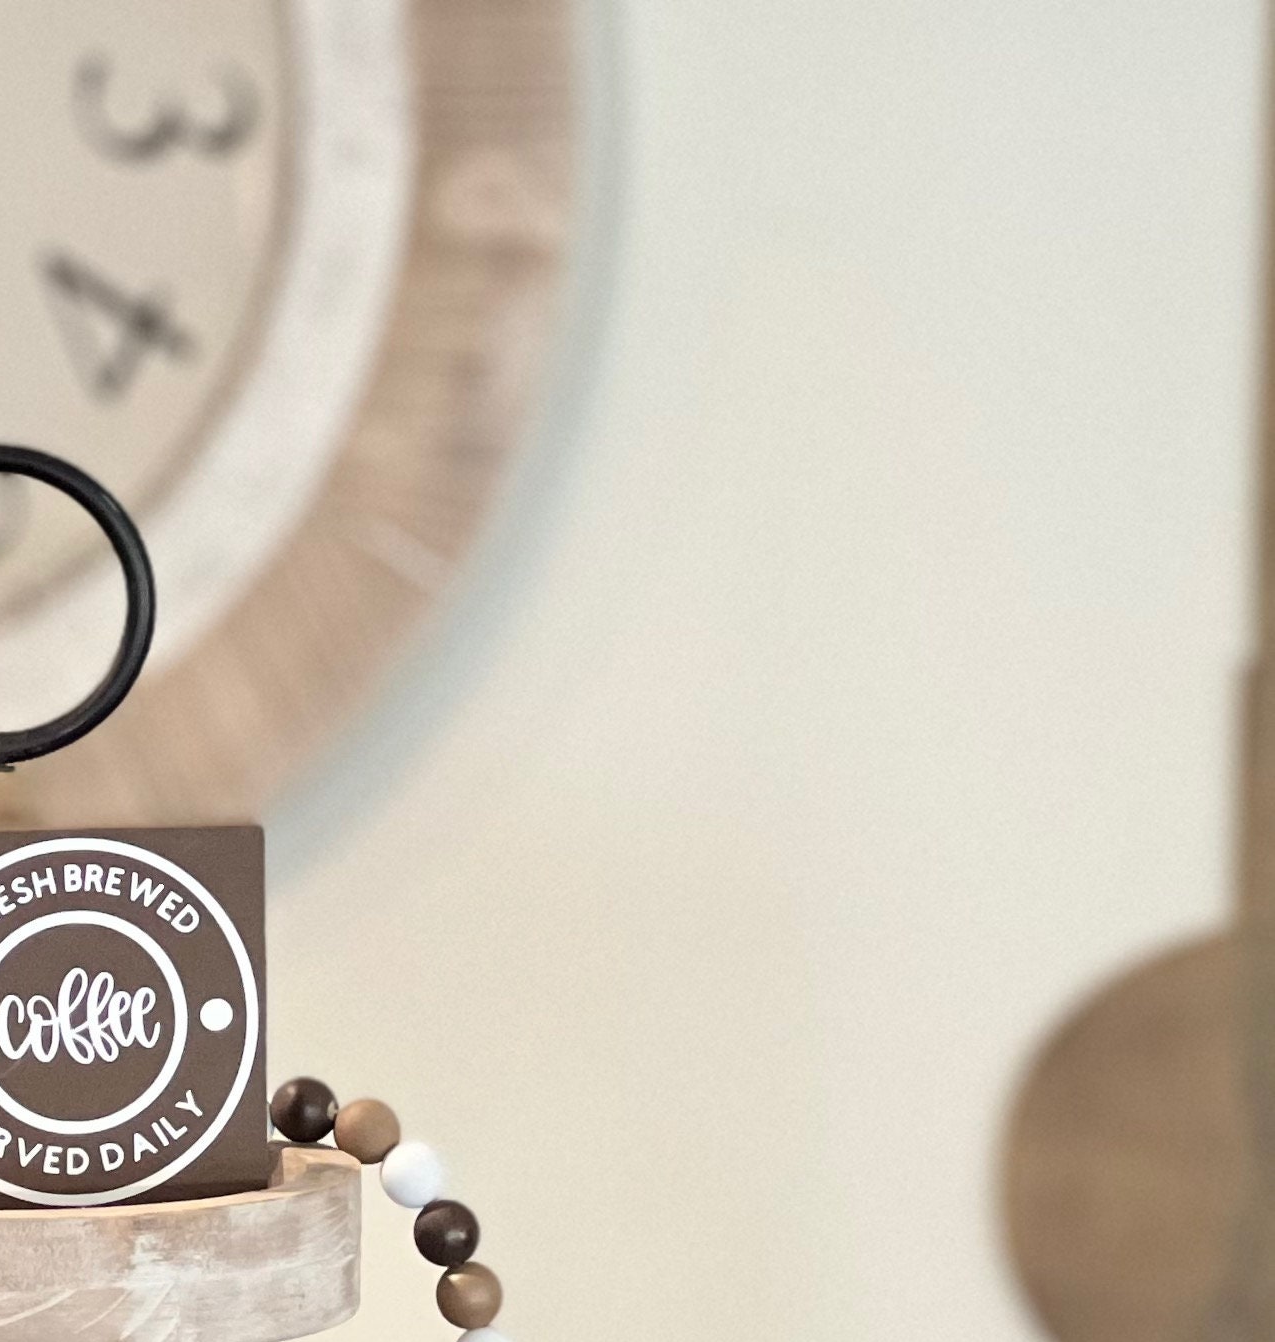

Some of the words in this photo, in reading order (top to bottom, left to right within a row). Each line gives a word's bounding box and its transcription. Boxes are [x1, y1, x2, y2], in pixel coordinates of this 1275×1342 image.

[71, 49, 261, 165] 3
[38, 244, 197, 404] 4
[63, 863, 201, 934] BREWED
[99, 1089, 204, 1173] DAILY
